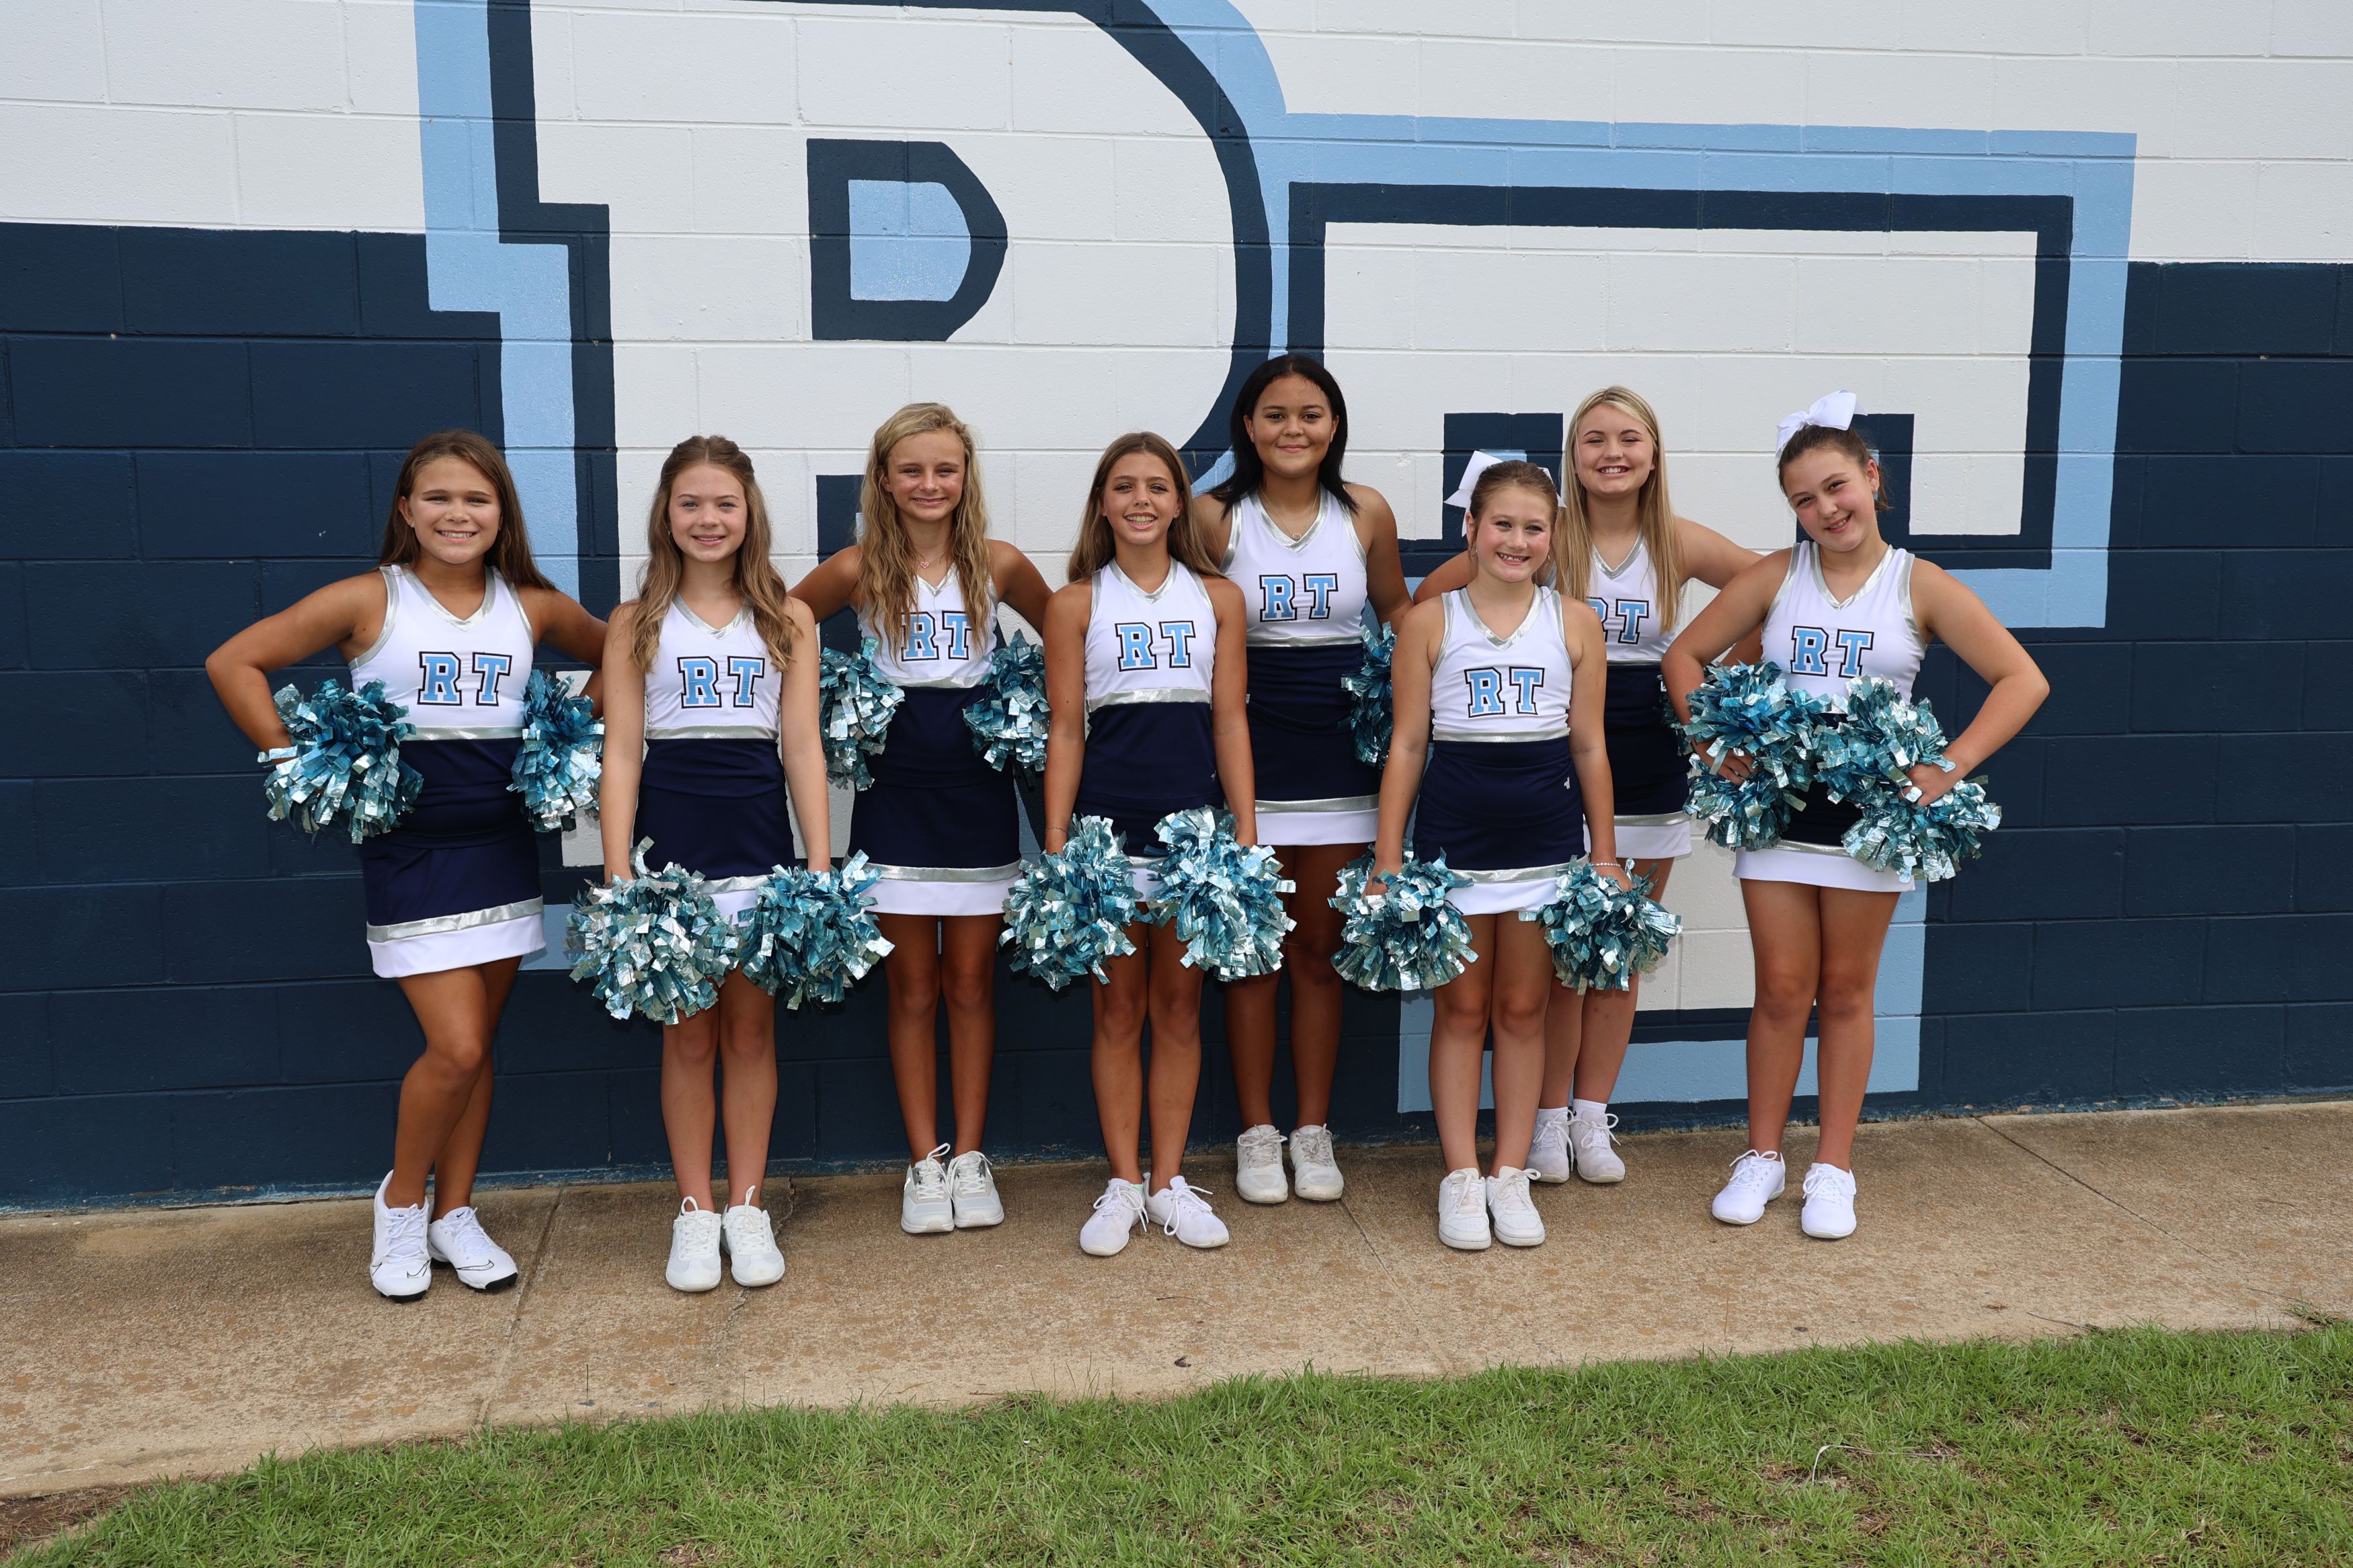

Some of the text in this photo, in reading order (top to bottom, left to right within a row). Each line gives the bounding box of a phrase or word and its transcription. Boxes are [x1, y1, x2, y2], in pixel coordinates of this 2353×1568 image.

[1259, 573, 1339, 622] RT
[901, 610, 973, 661] RT
[1115, 620, 1196, 672] RT
[1790, 626, 1874, 677] RT
[417, 651, 512, 706] RT
[678, 656, 765, 708] RT
[1464, 667, 1545, 718] RT
